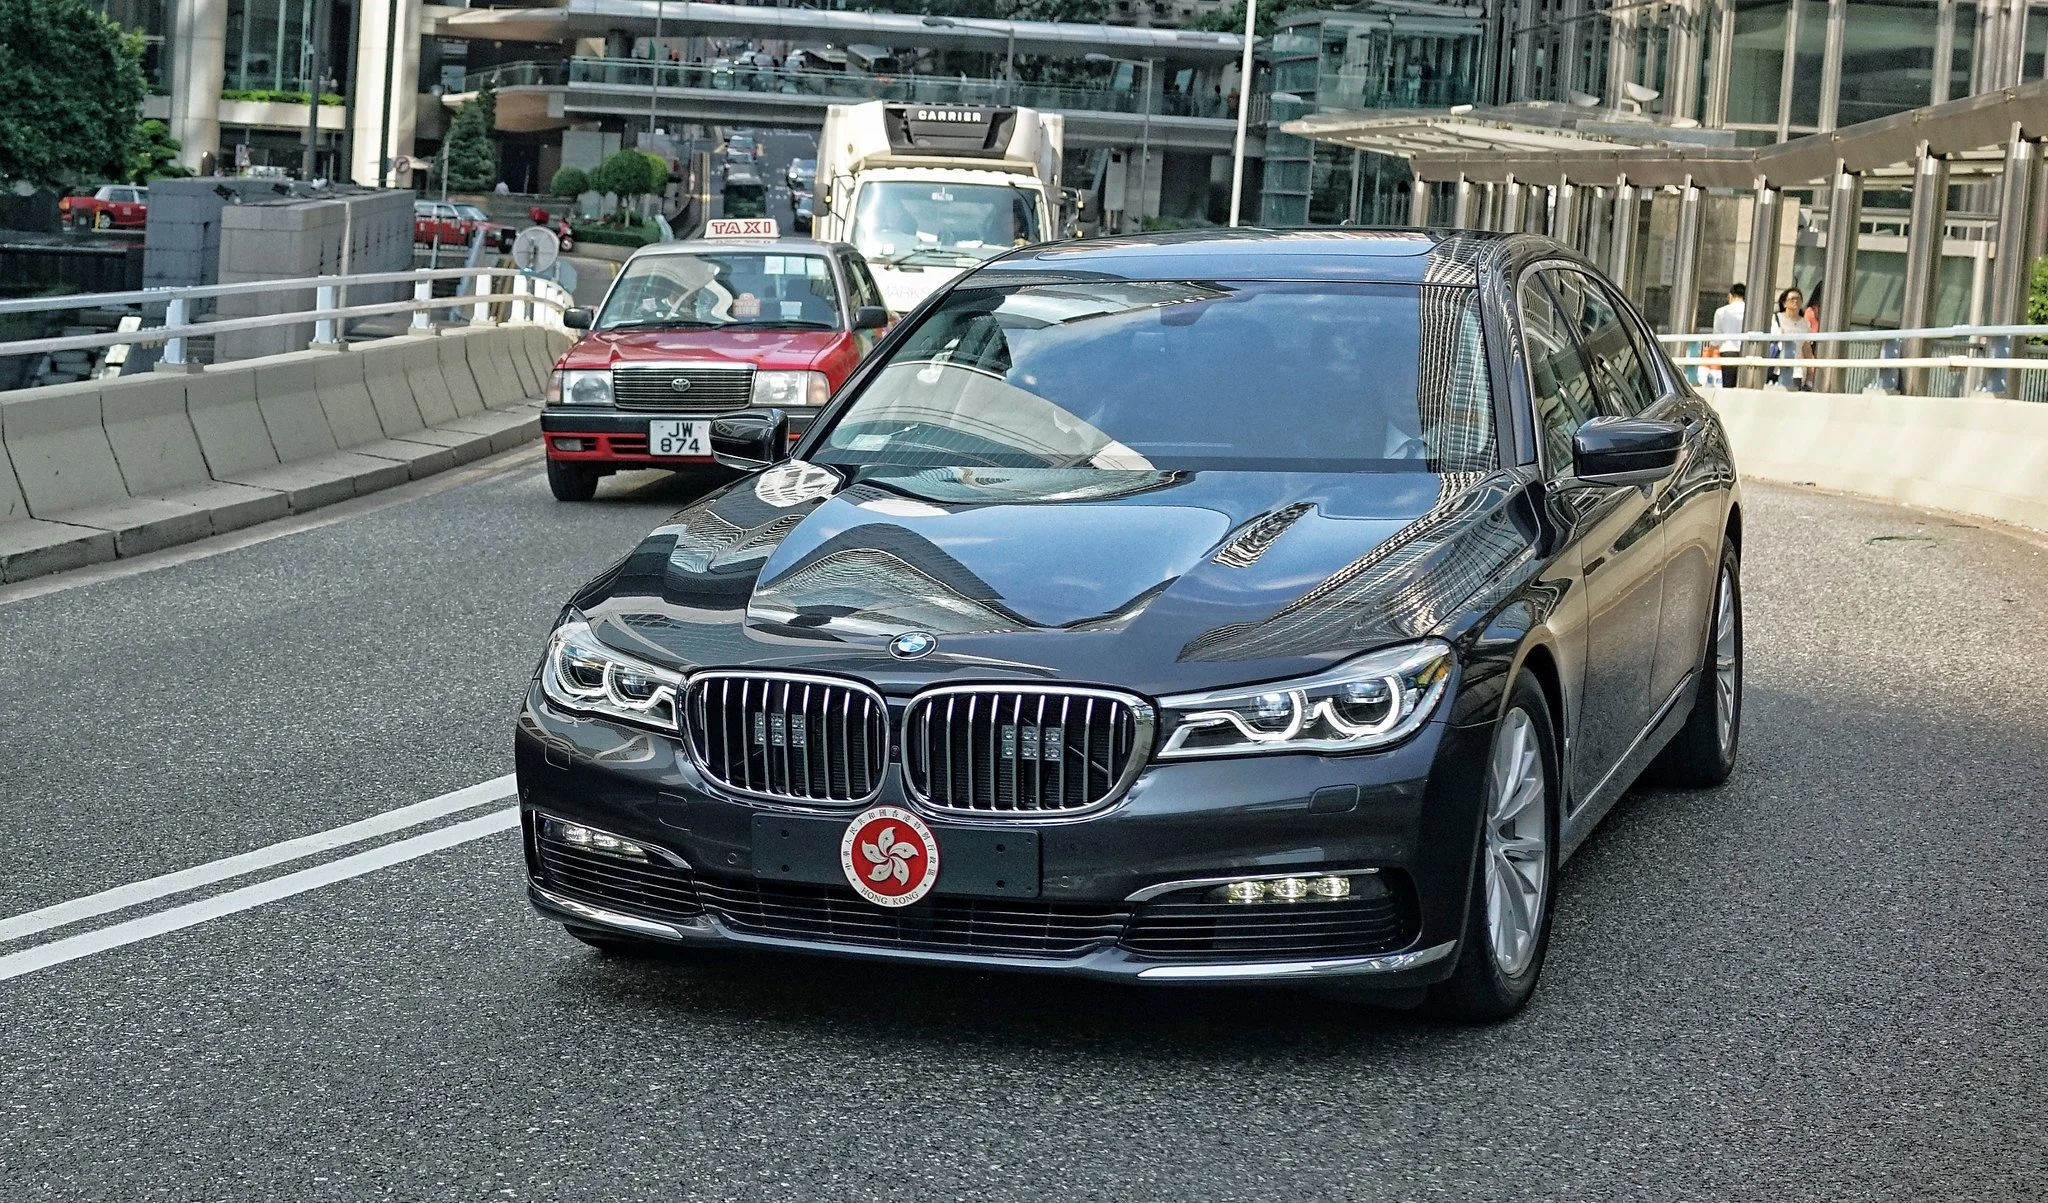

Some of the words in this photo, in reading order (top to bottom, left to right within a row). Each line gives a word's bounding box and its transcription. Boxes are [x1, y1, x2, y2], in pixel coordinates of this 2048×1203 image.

[918, 110, 982, 122] CARRIER
[712, 221, 771, 234] TAXI
[668, 422, 693, 437] JW
[661, 438, 700, 453] 874
[860, 887, 888, 905] HONG
[892, 891, 919, 906] KONG
